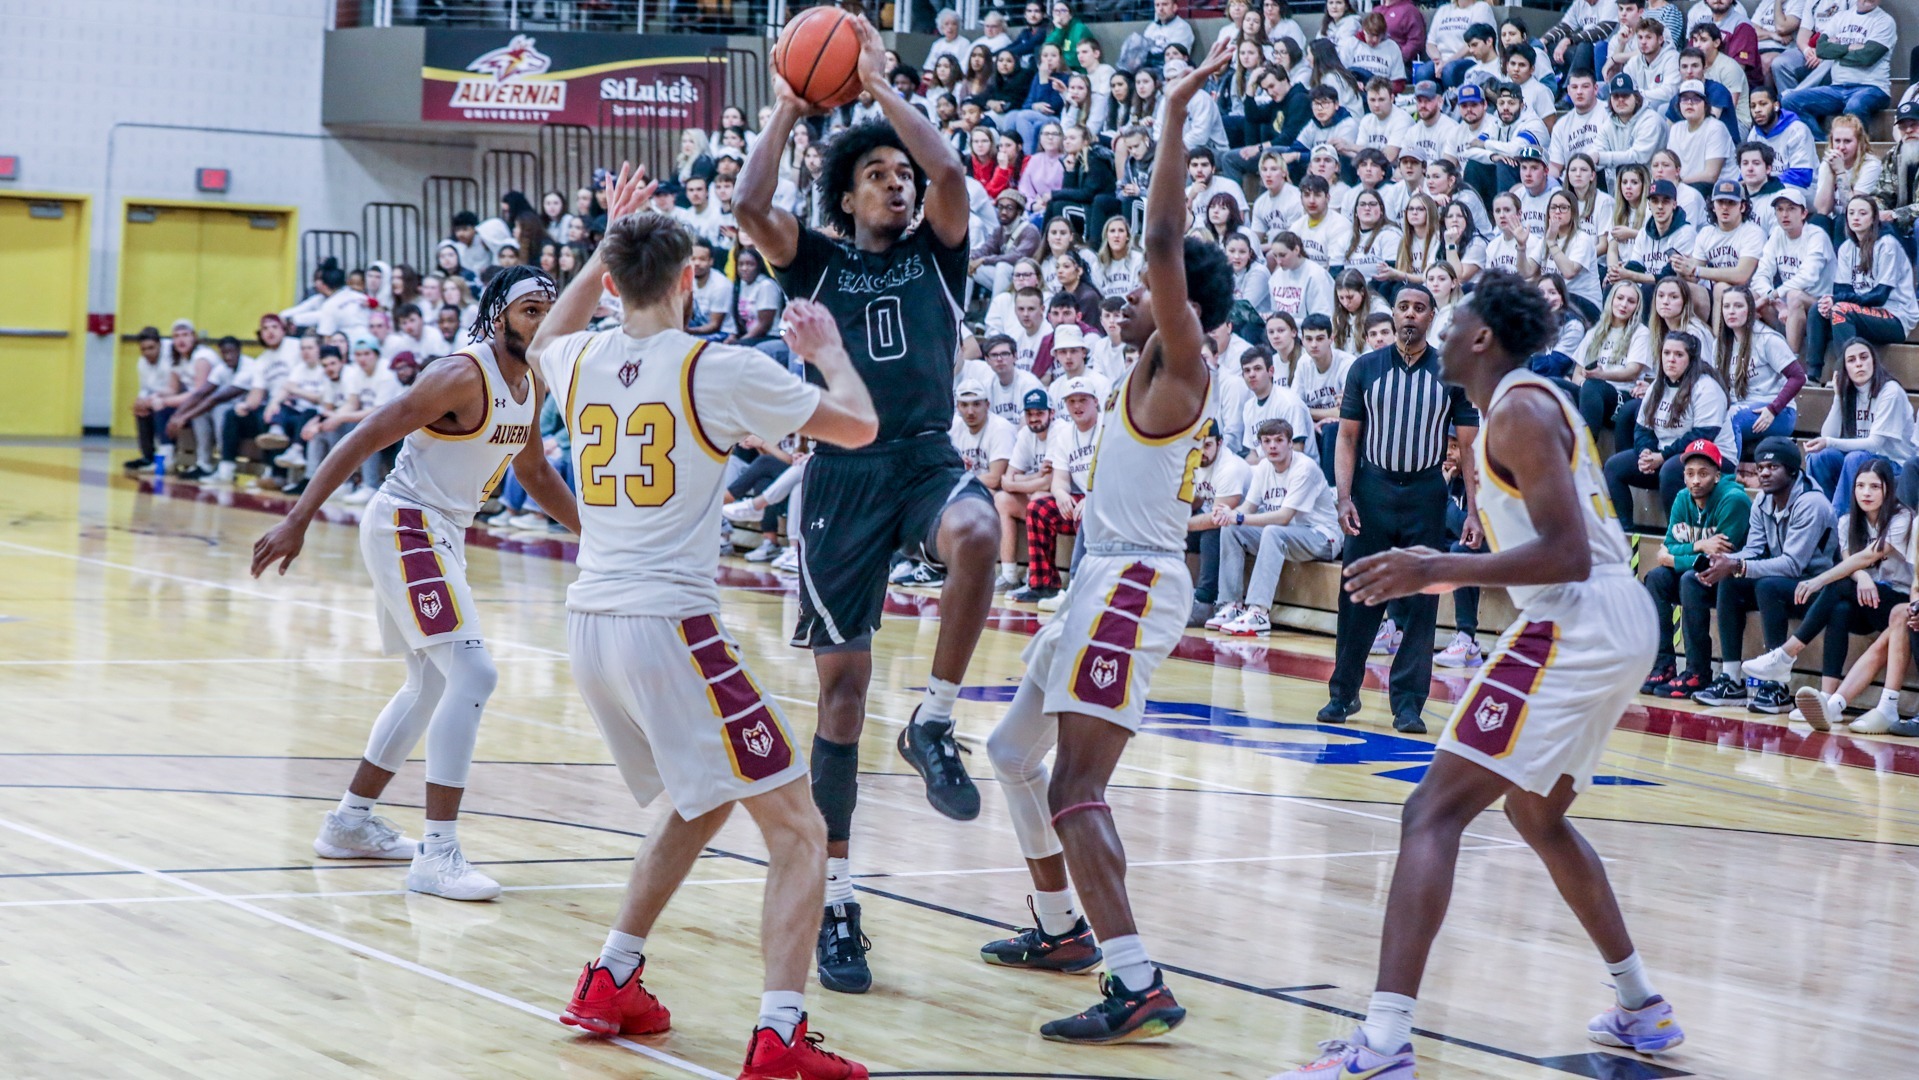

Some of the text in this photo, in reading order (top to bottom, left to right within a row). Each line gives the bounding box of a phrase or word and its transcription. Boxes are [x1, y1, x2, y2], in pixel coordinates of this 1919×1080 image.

[1352, 55, 1389, 68] ALVERNIA
[458, 83, 560, 105] ALVERNIA
[463, 109, 550, 120] UNIVERSITY
[838, 254, 925, 294] EAGLES
[865, 295, 907, 361] 0
[579, 402, 676, 507] 23
